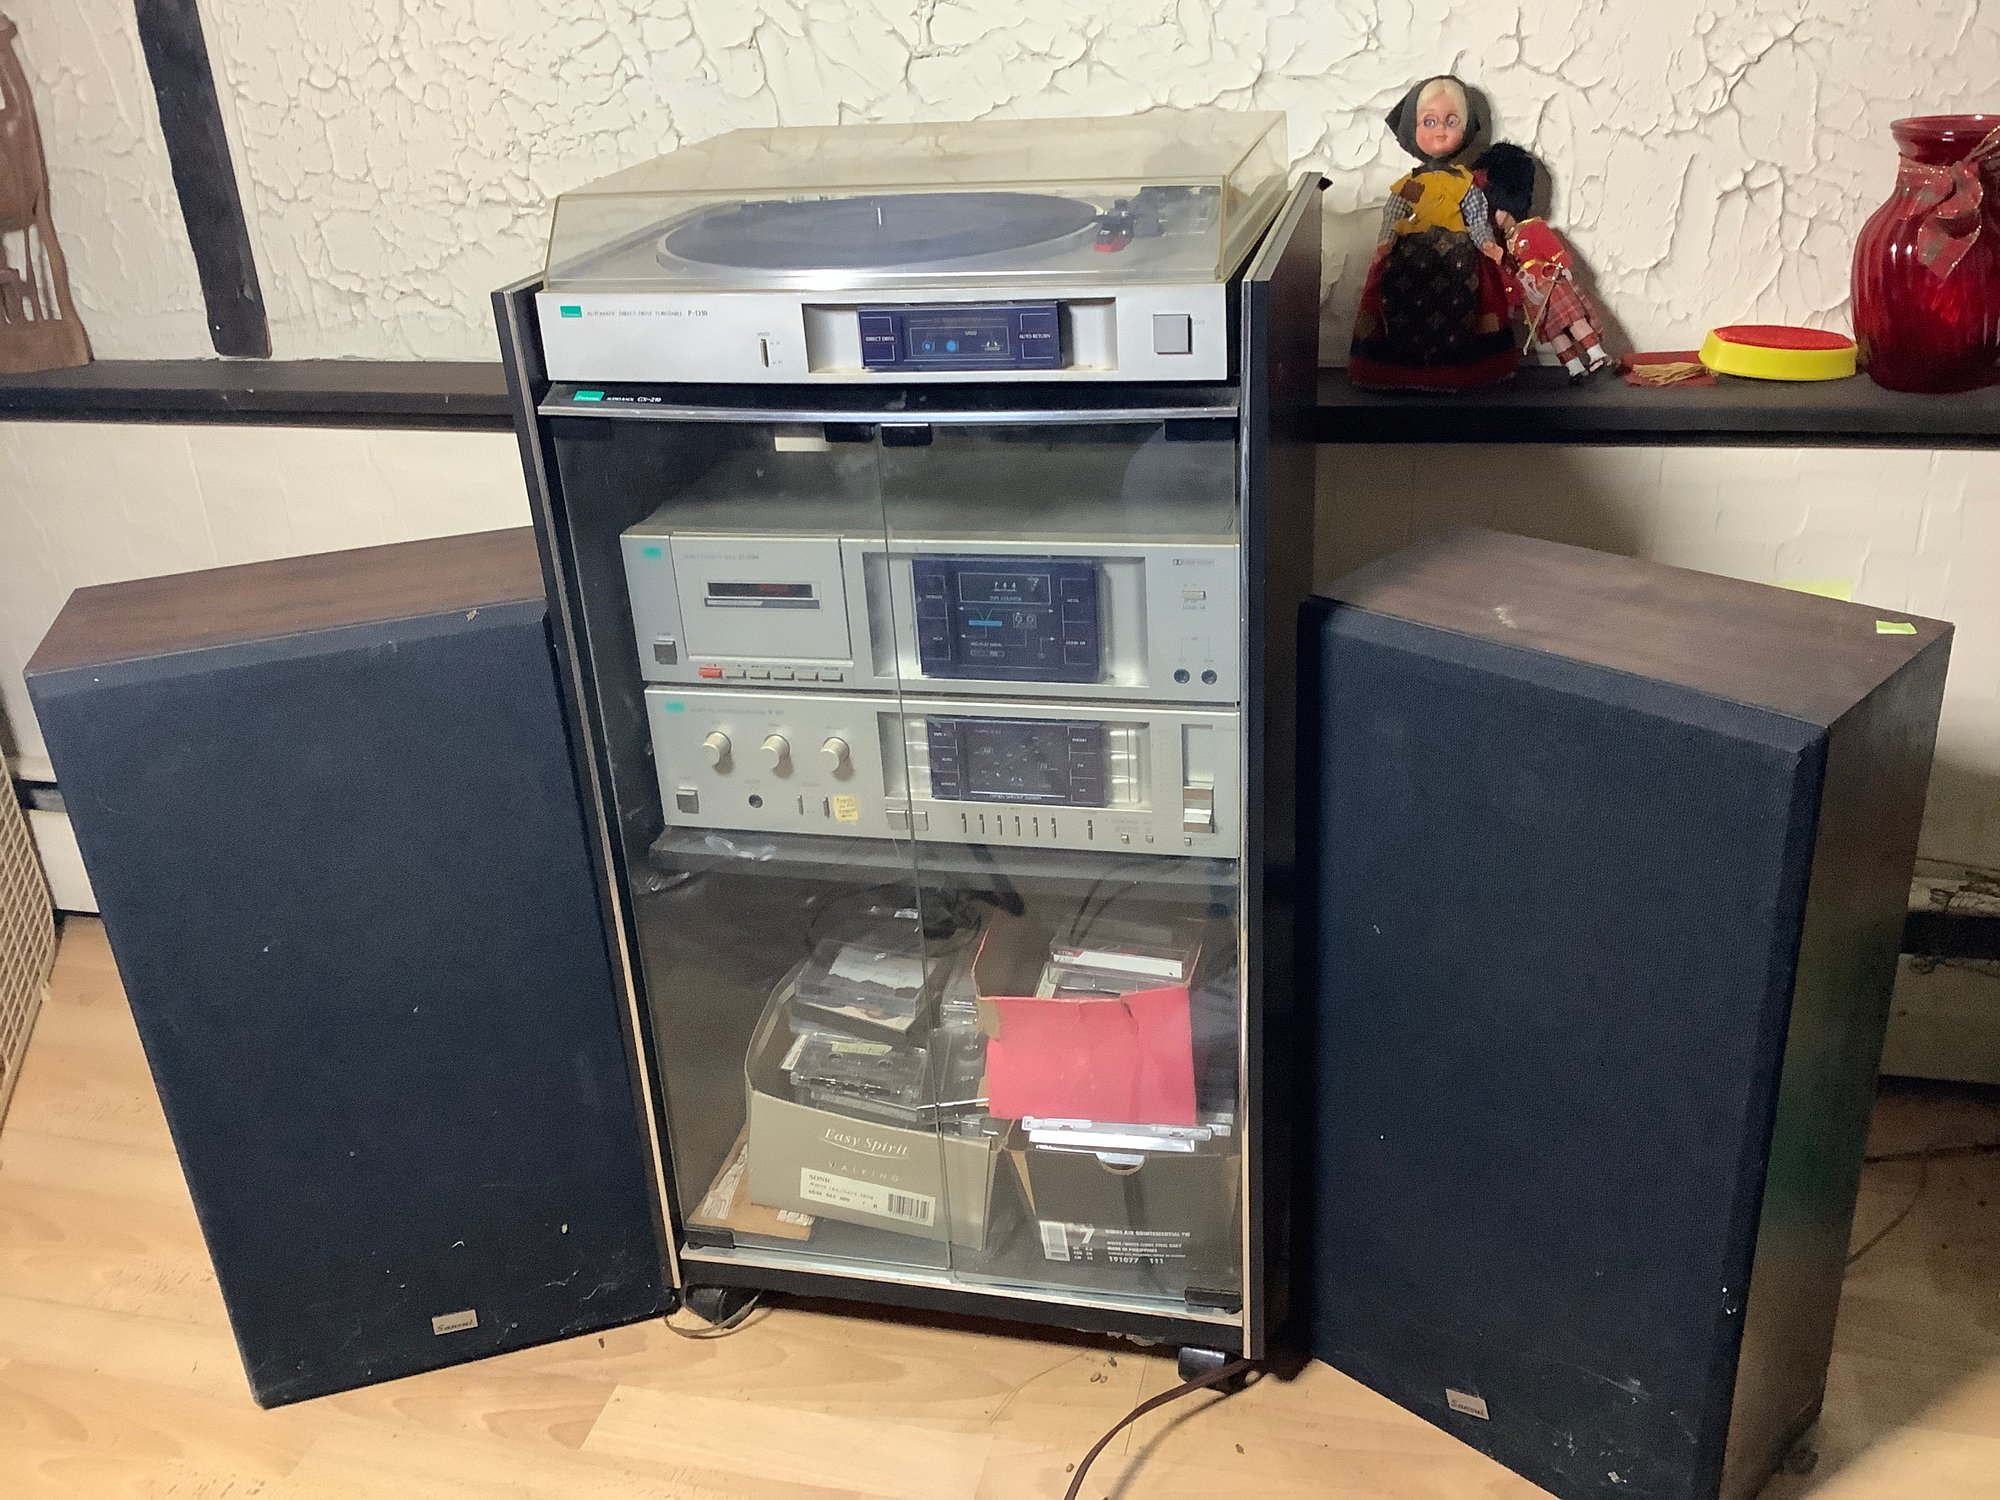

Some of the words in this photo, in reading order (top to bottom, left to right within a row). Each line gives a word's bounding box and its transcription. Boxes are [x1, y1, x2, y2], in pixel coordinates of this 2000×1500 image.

[825, 1128, 861, 1147] Easy
[864, 1137, 908, 1155] Spirit
[1079, 1228, 1096, 1244] 7
[1109, 1256, 1140, 1265] 191077
